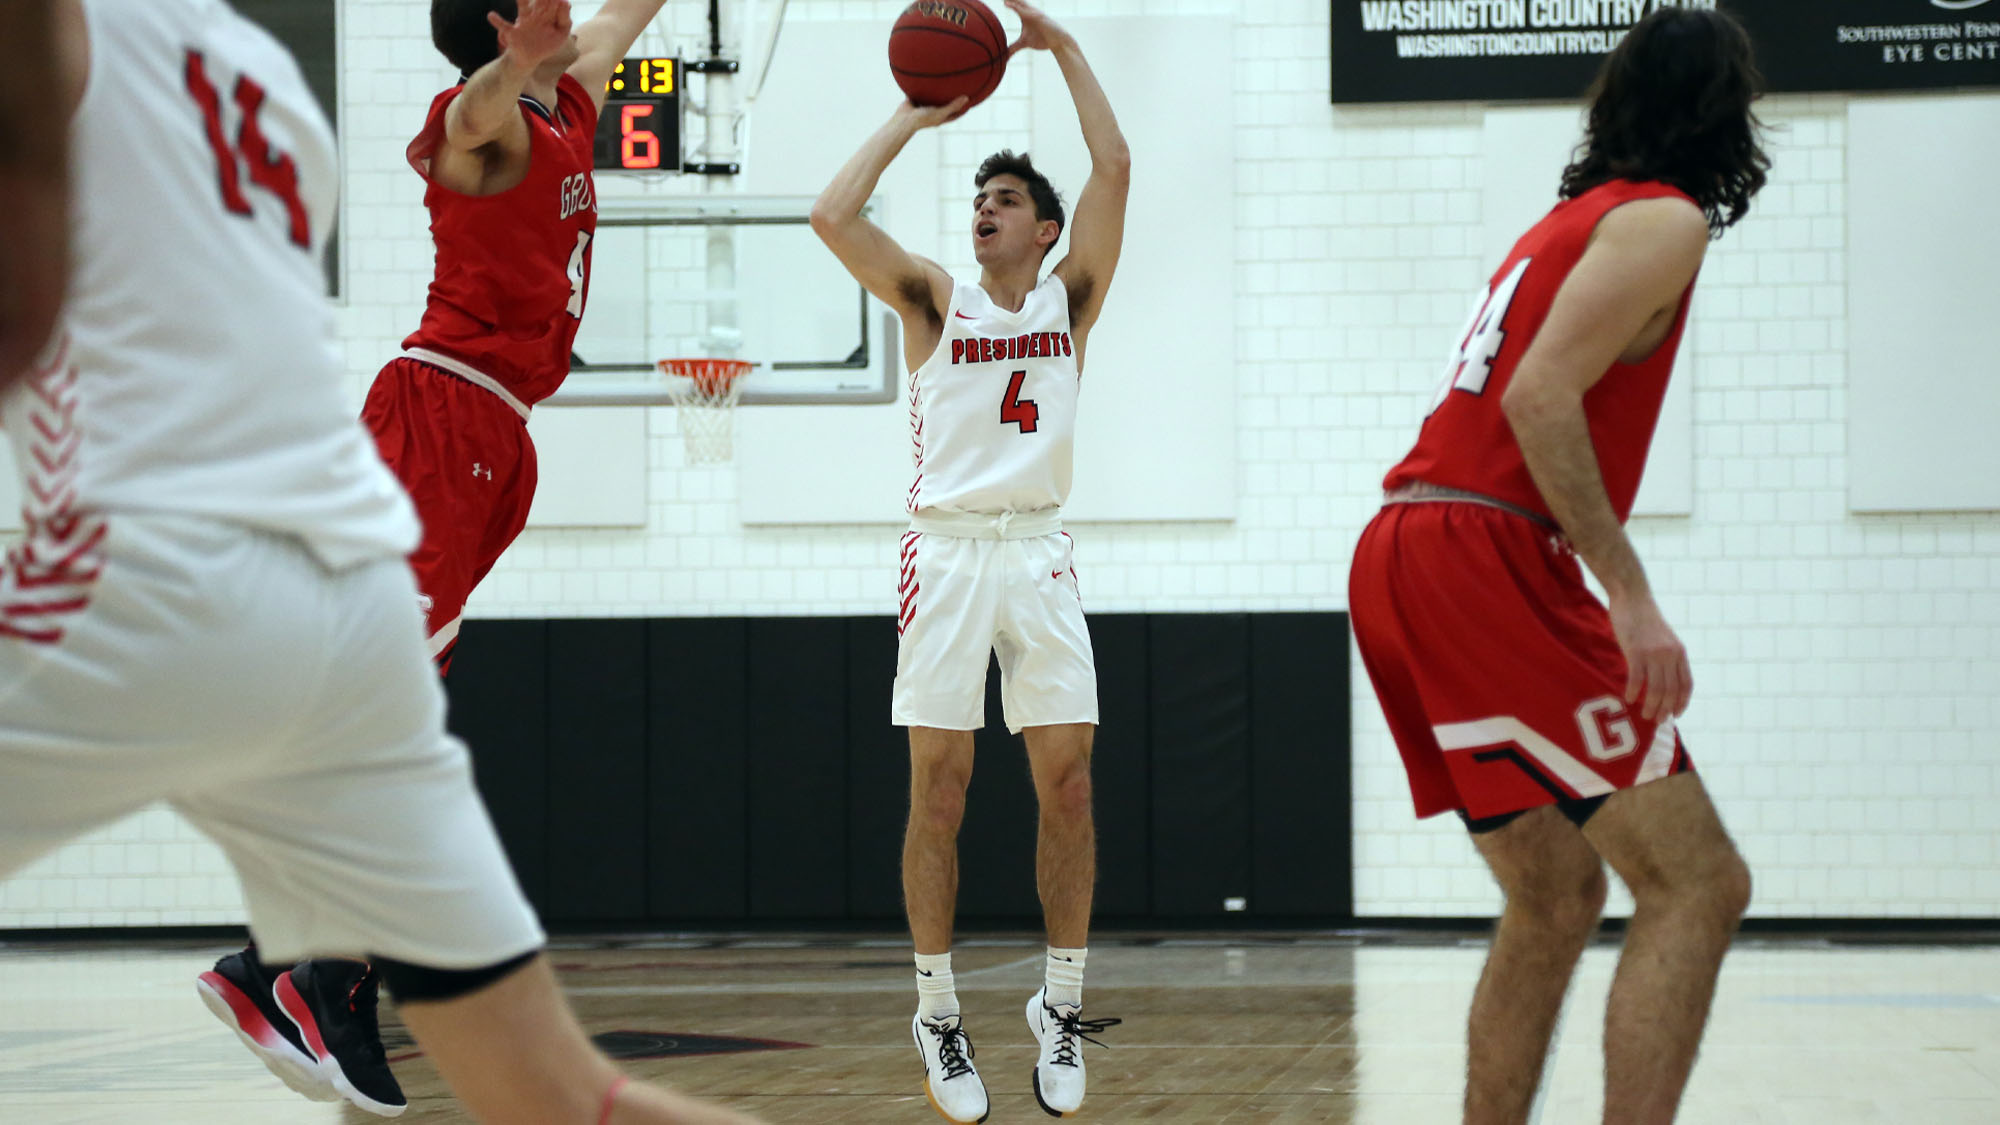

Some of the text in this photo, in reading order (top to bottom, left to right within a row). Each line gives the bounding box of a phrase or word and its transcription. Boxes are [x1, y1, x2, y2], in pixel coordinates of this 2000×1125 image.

[1360, 0, 1526, 31] WASHINGTON
[1529, 0, 1647, 27] COUNTRY
[1837, 23, 1961, 43] SOUTHWESTERN
[1883, 41, 2000, 63] EYE CENT
[183, 48, 312, 252] 14
[621, 104, 660, 169] 6
[951, 331, 1072, 365] PRESIDENTS
[1000, 369, 1039, 434] 4
[1575, 694, 1639, 762] G
